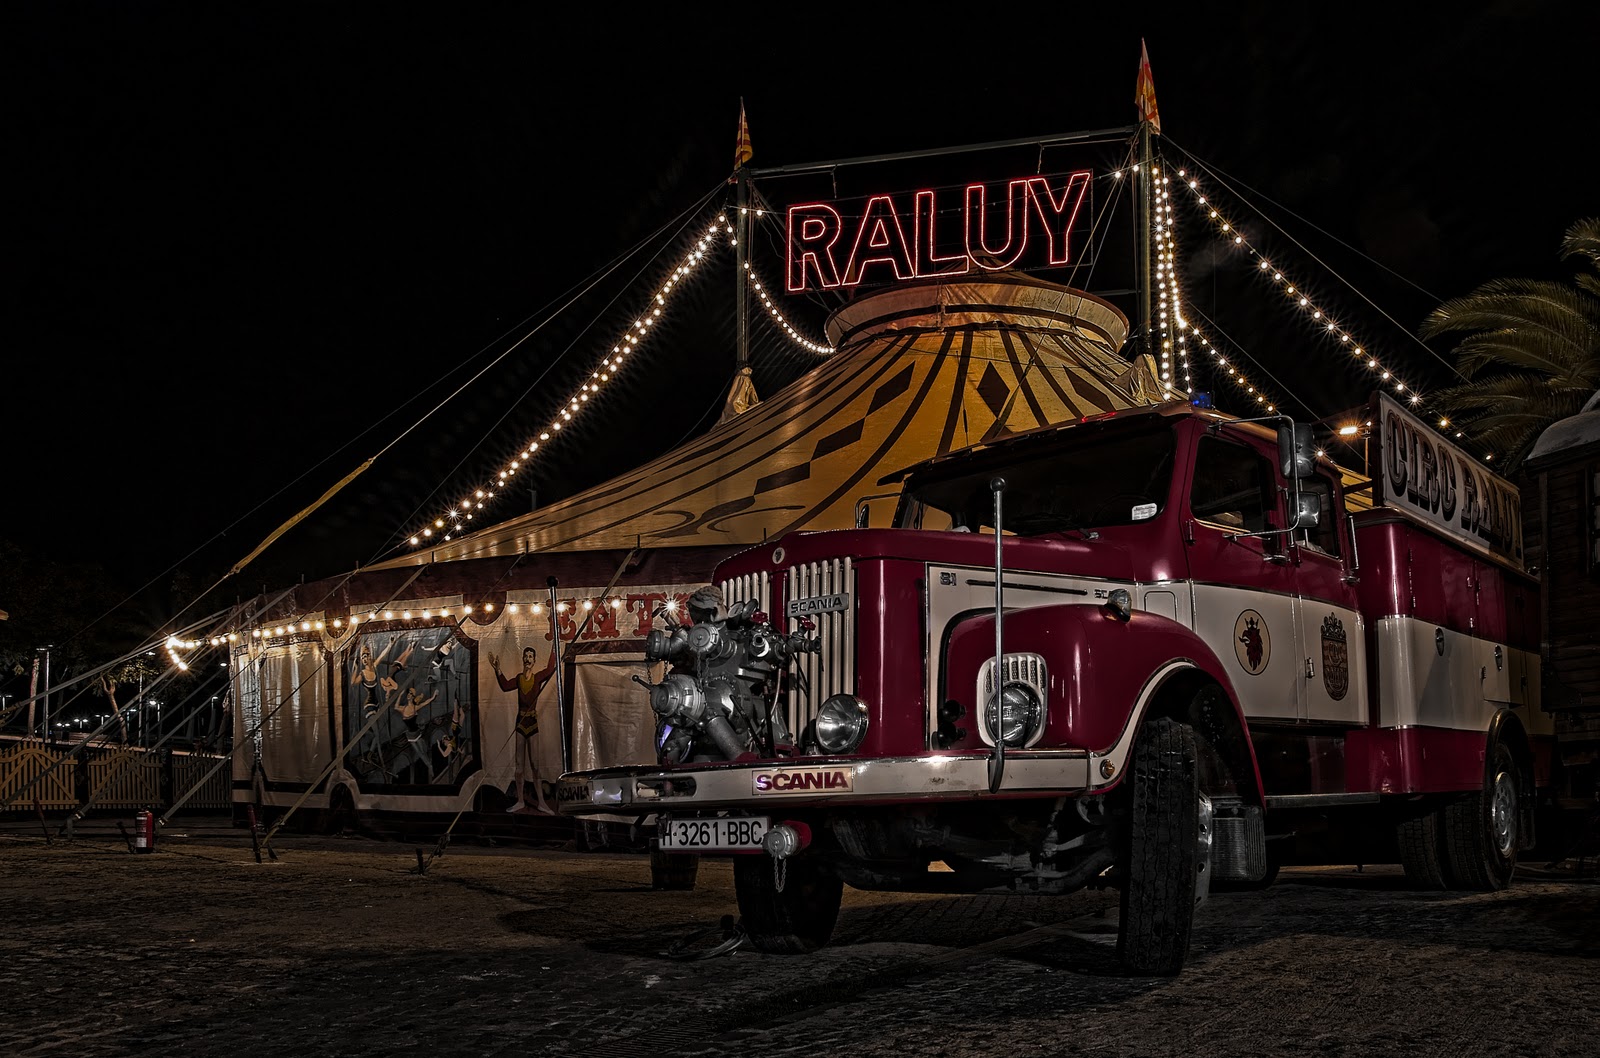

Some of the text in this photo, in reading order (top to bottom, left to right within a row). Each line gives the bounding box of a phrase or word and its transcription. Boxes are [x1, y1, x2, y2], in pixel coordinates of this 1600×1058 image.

[787, 173, 1091, 292] RALUY
[1386, 411, 1456, 522] CIRC
[790, 596, 843, 614] SCANIA
[755, 771, 850, 791] SCANIA
